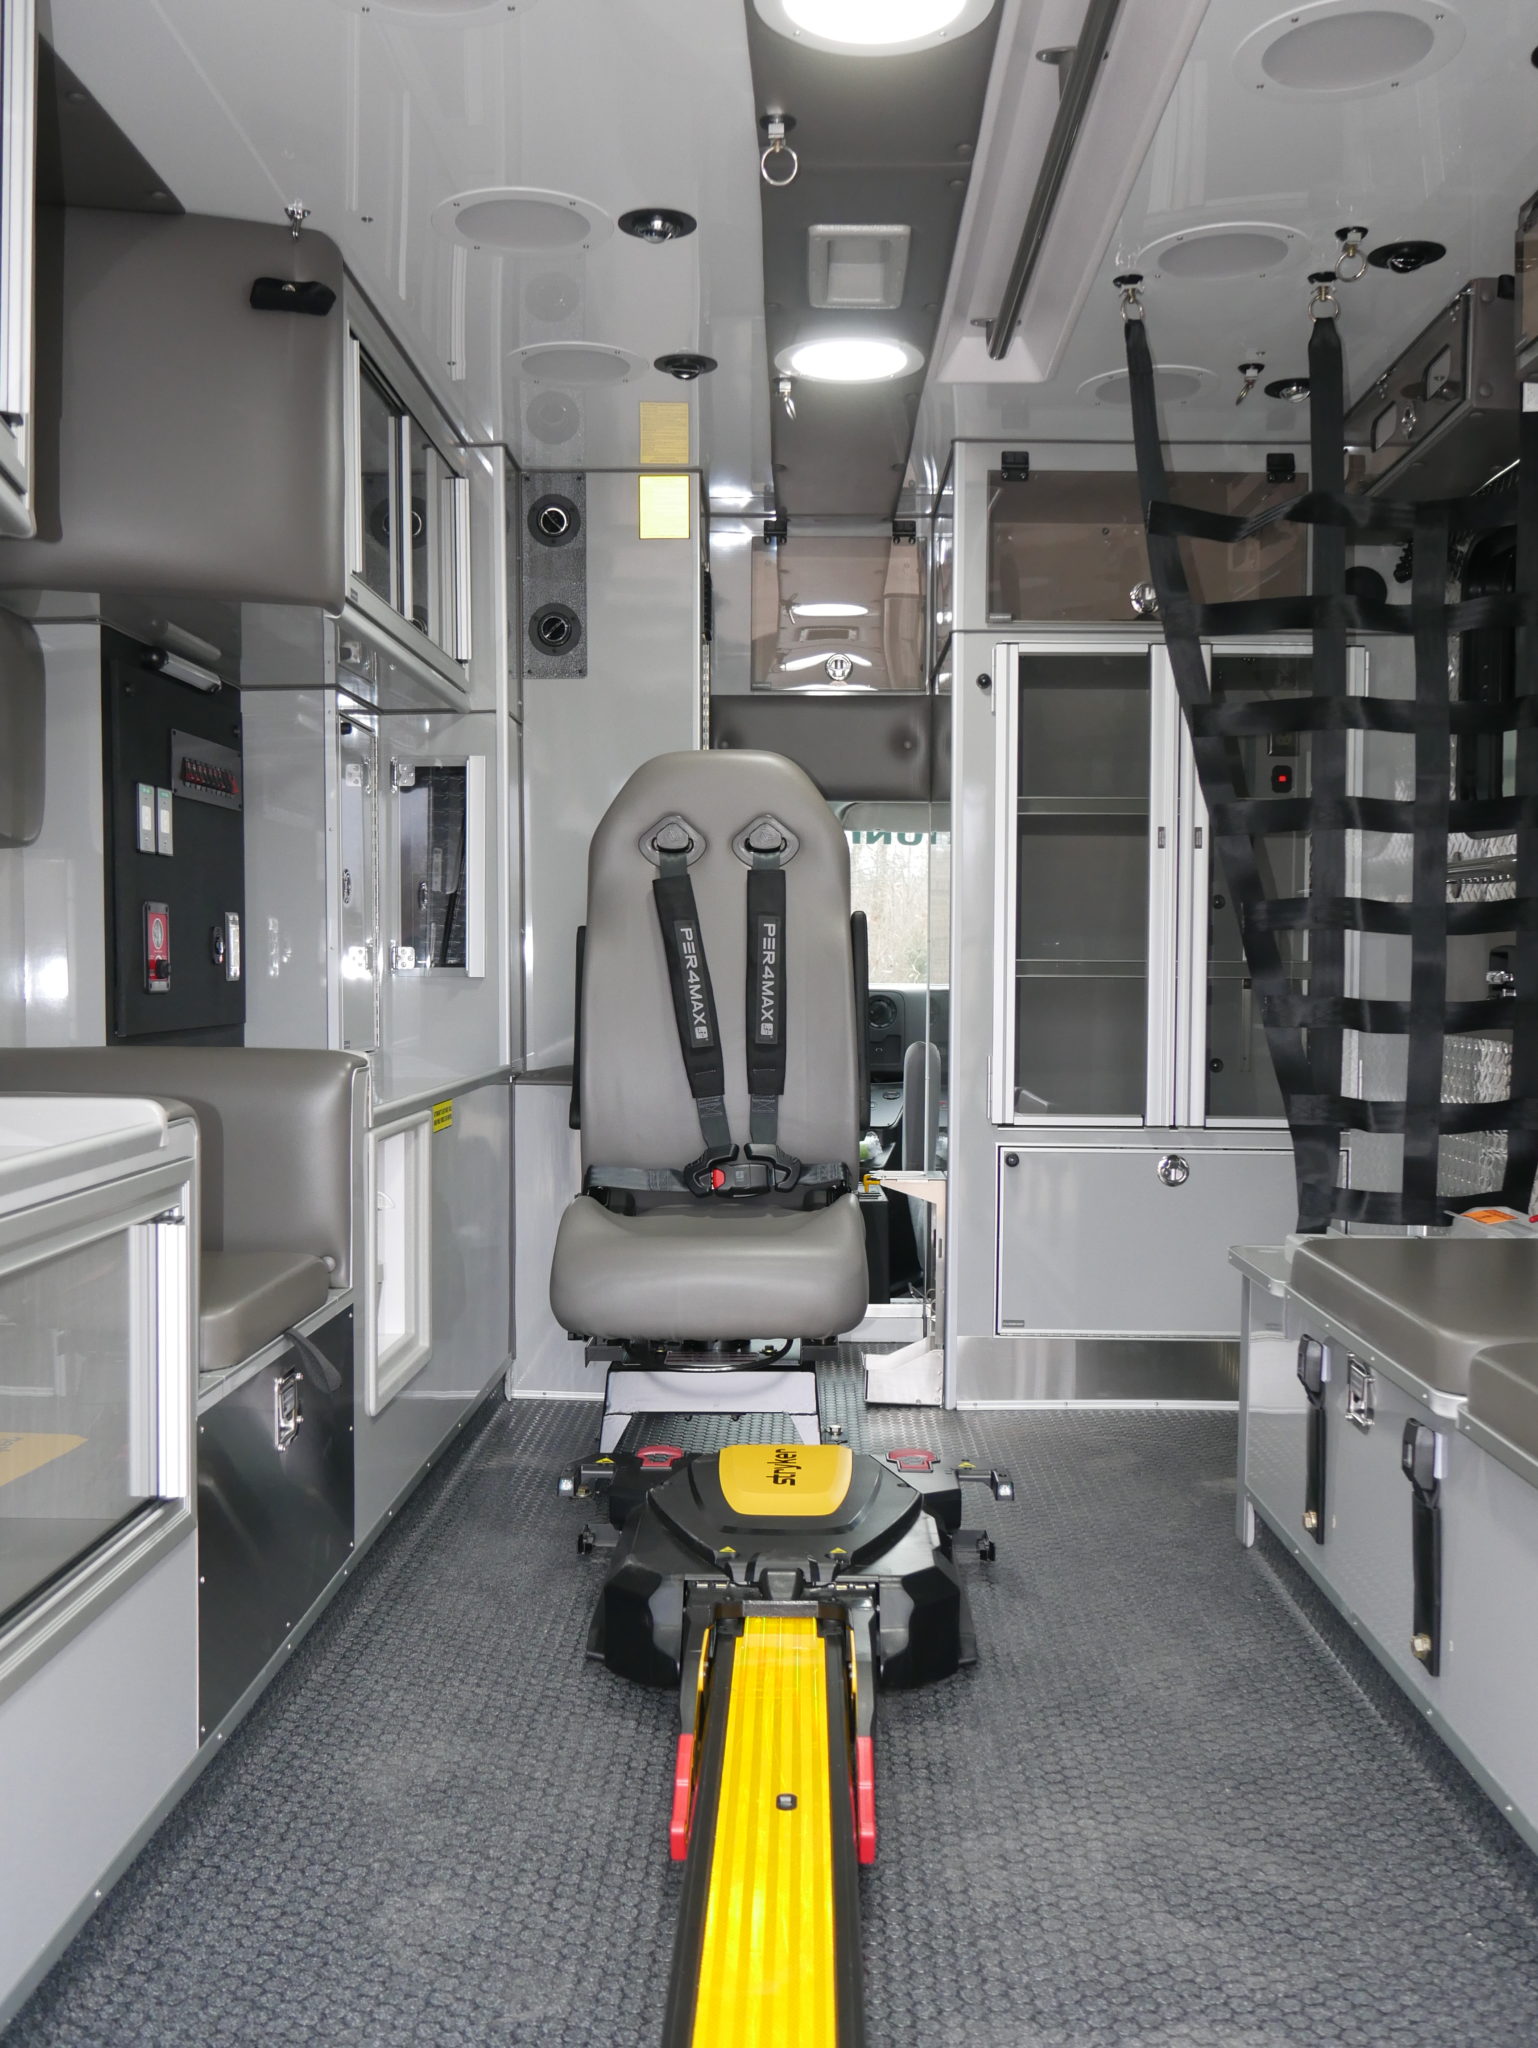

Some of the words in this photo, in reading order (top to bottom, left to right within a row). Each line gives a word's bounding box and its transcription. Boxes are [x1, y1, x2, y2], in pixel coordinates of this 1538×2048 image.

[680, 927, 707, 1025] PER4MAX
[761, 923, 777, 1022] PER4MAX
[765, 1448, 802, 1486] stryker
